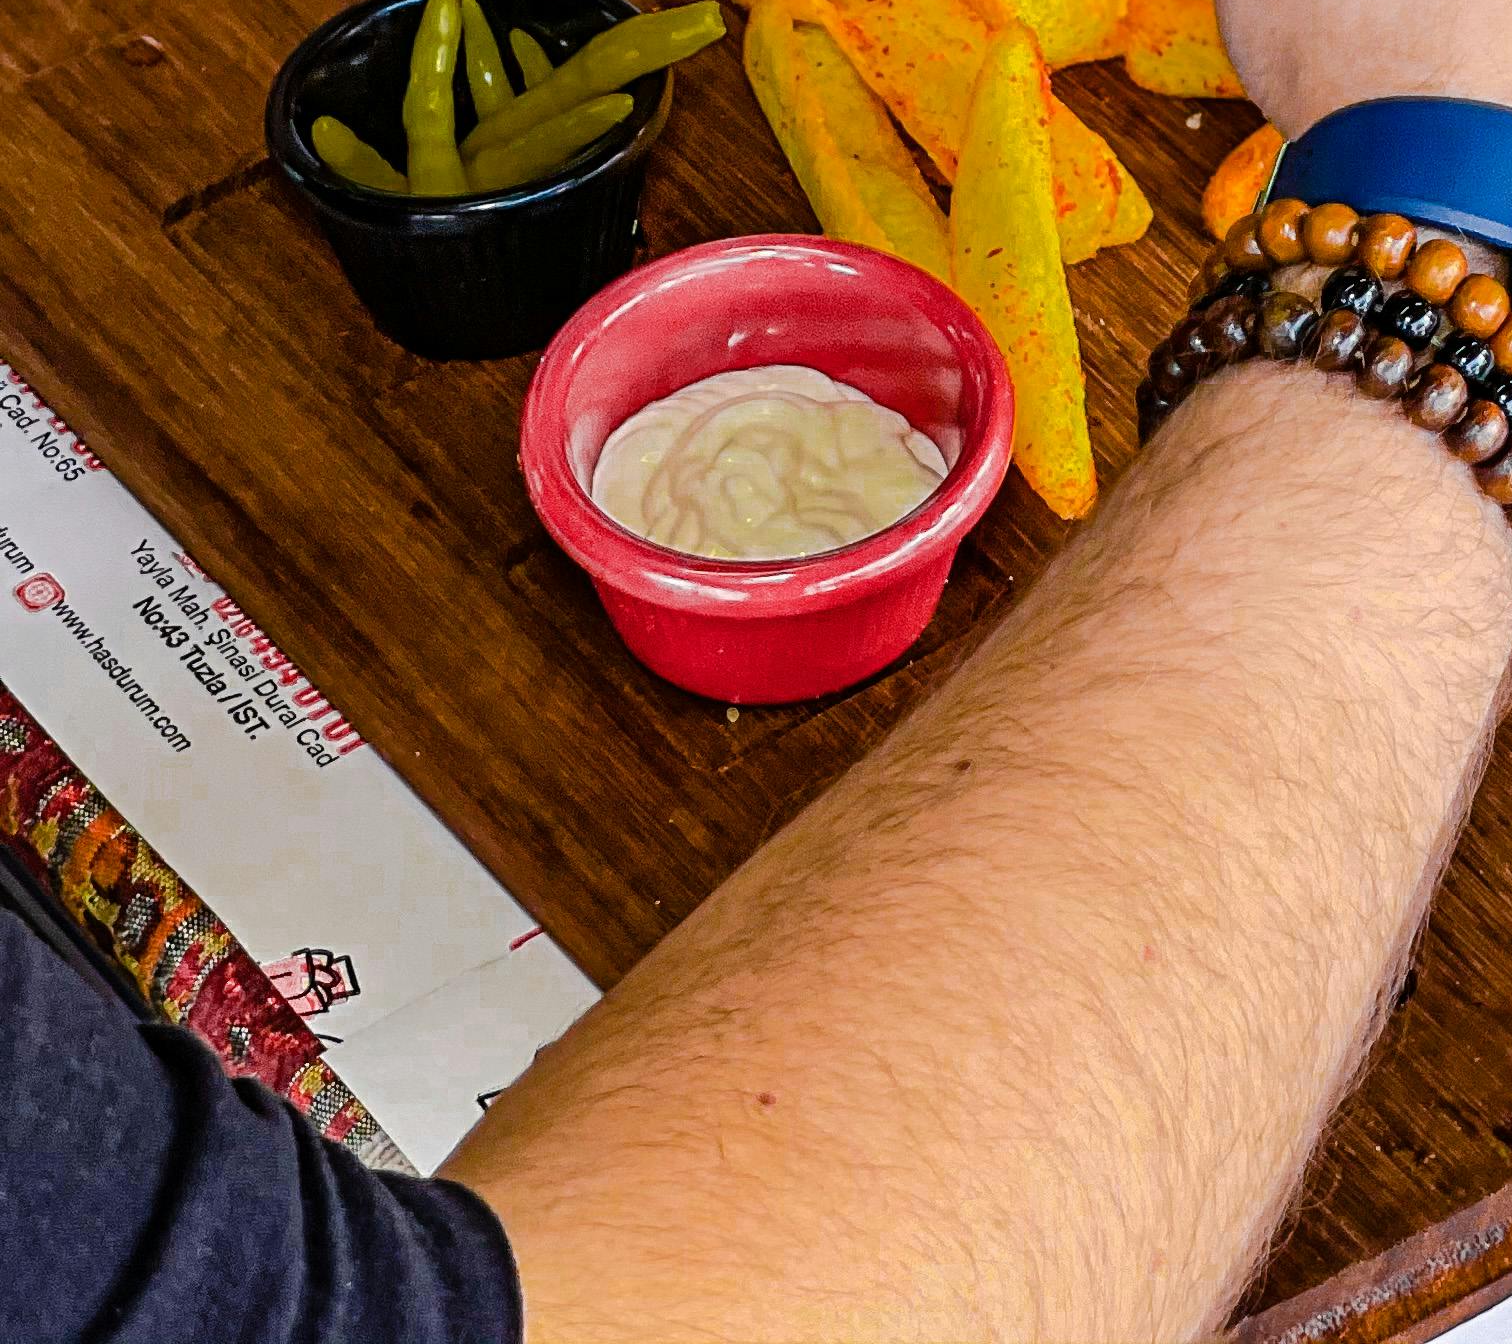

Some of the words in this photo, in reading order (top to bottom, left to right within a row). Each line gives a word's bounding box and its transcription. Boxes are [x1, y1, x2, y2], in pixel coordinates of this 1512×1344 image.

[0, 394, 40, 434] Cad.
[31, 431, 86, 481] No:65
[52, 599, 192, 753] www.hasdurum.com
[130, 539, 175, 589] Yayla
[168, 584, 210, 631] Mah.
[203, 627, 266, 682] Şinasi
[252, 678, 310, 730] Dural
[296, 727, 340, 768] Cad
[132, 595, 190, 648] No:43
[179, 644, 227, 697] Tuzla
